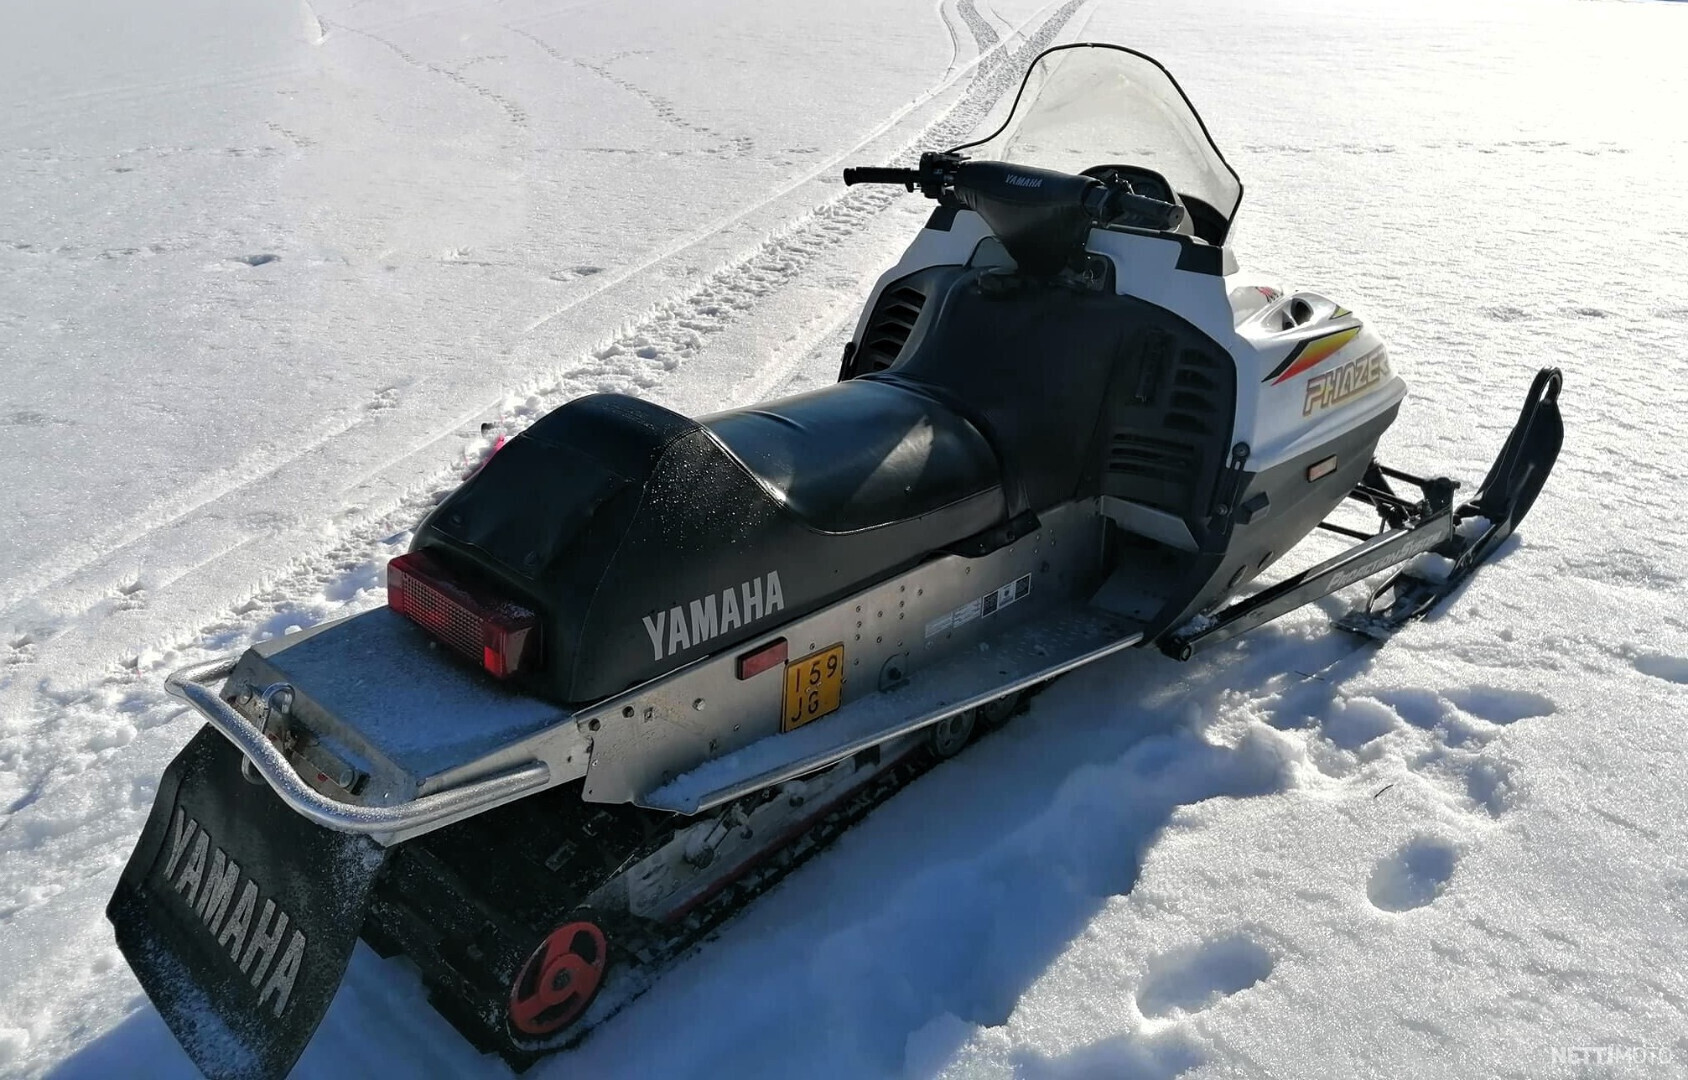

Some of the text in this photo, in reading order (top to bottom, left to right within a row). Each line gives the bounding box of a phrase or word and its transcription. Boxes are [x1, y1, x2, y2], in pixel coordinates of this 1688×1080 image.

[1005, 174, 1042, 188] YAMAHA
[1303, 344, 1390, 416] PHAZER
[642, 570, 784, 661] YAMAHA
[795, 655, 838, 692] 159
[791, 690, 820, 722] JG
[164, 805, 306, 1018] YAMAHA
